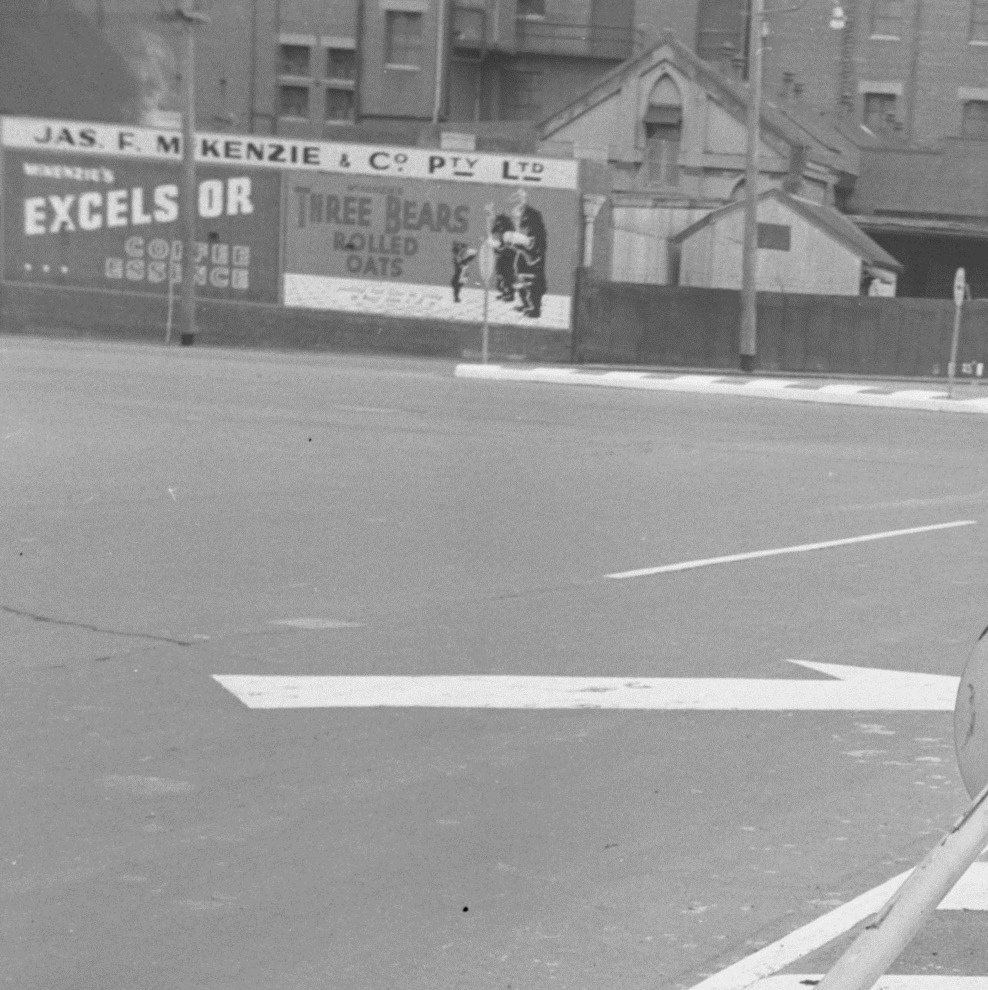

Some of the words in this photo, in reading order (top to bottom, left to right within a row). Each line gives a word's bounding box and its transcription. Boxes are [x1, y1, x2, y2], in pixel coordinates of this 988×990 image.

[34, 127, 104, 149] JAS.
[156, 135, 320, 165] MKENZIE
[339, 152, 350, 168] &
[24, 177, 253, 235] EXCELSOR
[294, 186, 373, 229] THREE
[385, 194, 470, 234] BEARS
[333, 231, 418, 256] ROLLED
[346, 255, 404, 278] OATS
